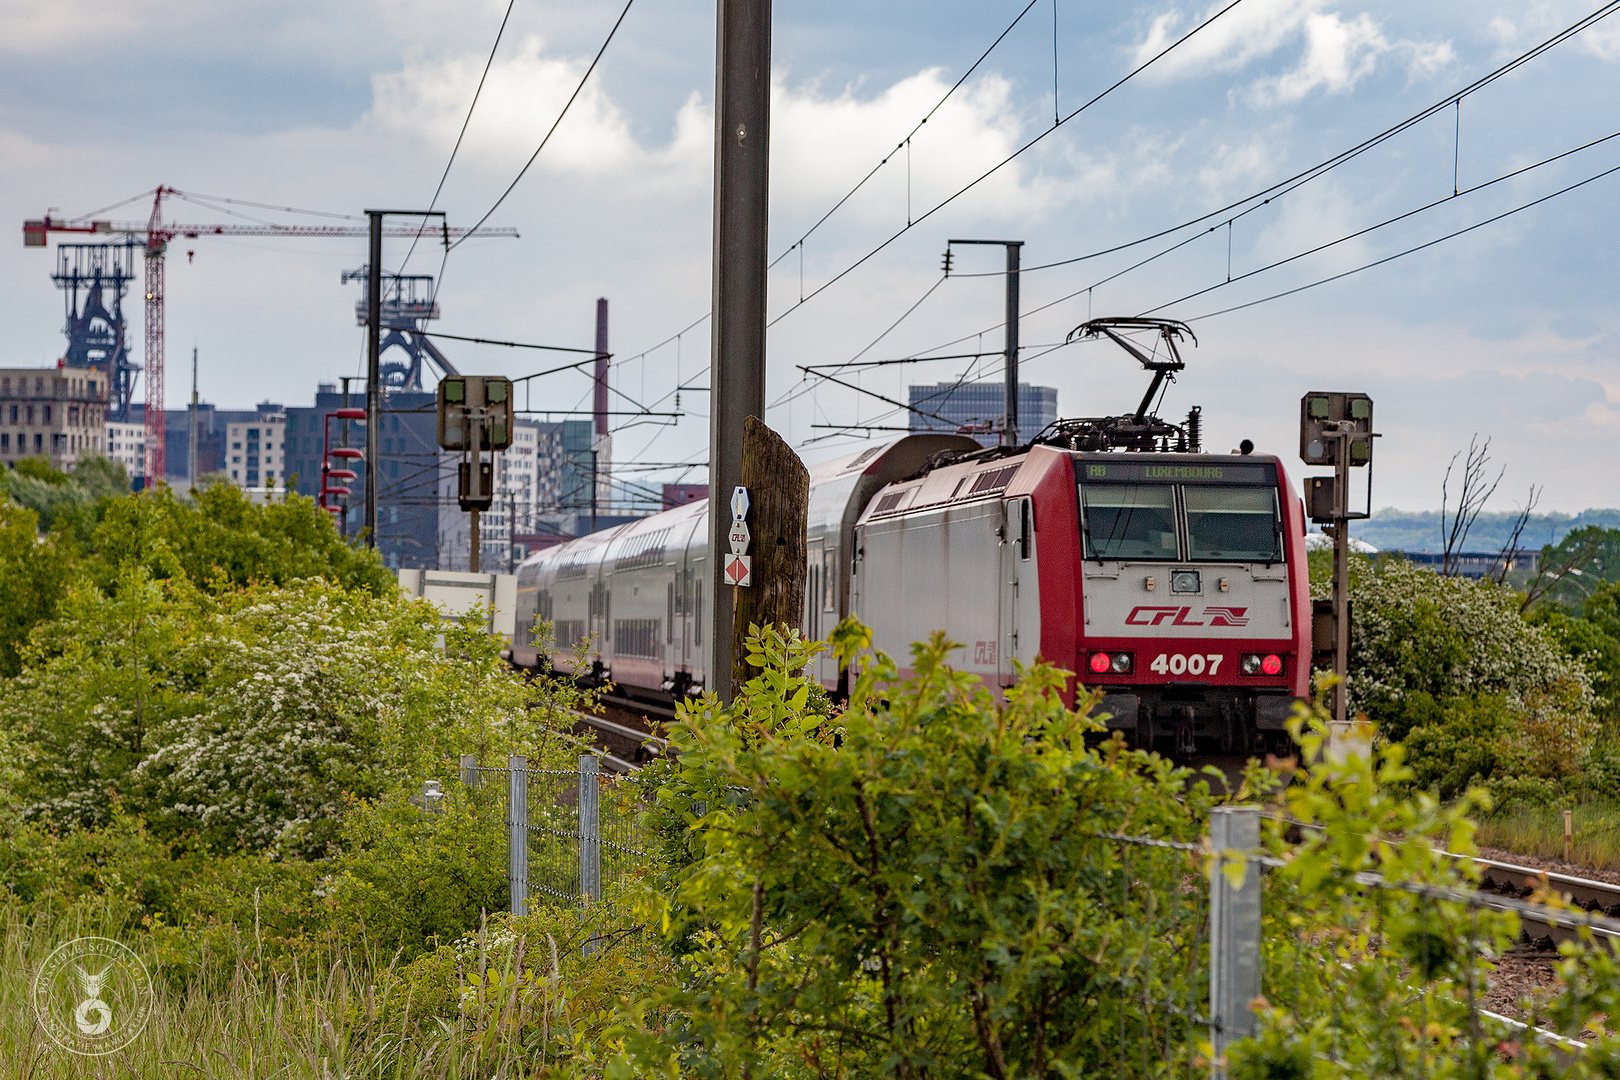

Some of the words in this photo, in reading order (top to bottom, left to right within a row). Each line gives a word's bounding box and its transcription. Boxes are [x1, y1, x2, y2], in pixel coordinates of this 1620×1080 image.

[1145, 465, 1223, 479] LUXEMBOURG
[1125, 606, 1206, 626] CFL
[1150, 653, 1224, 676] 4007
